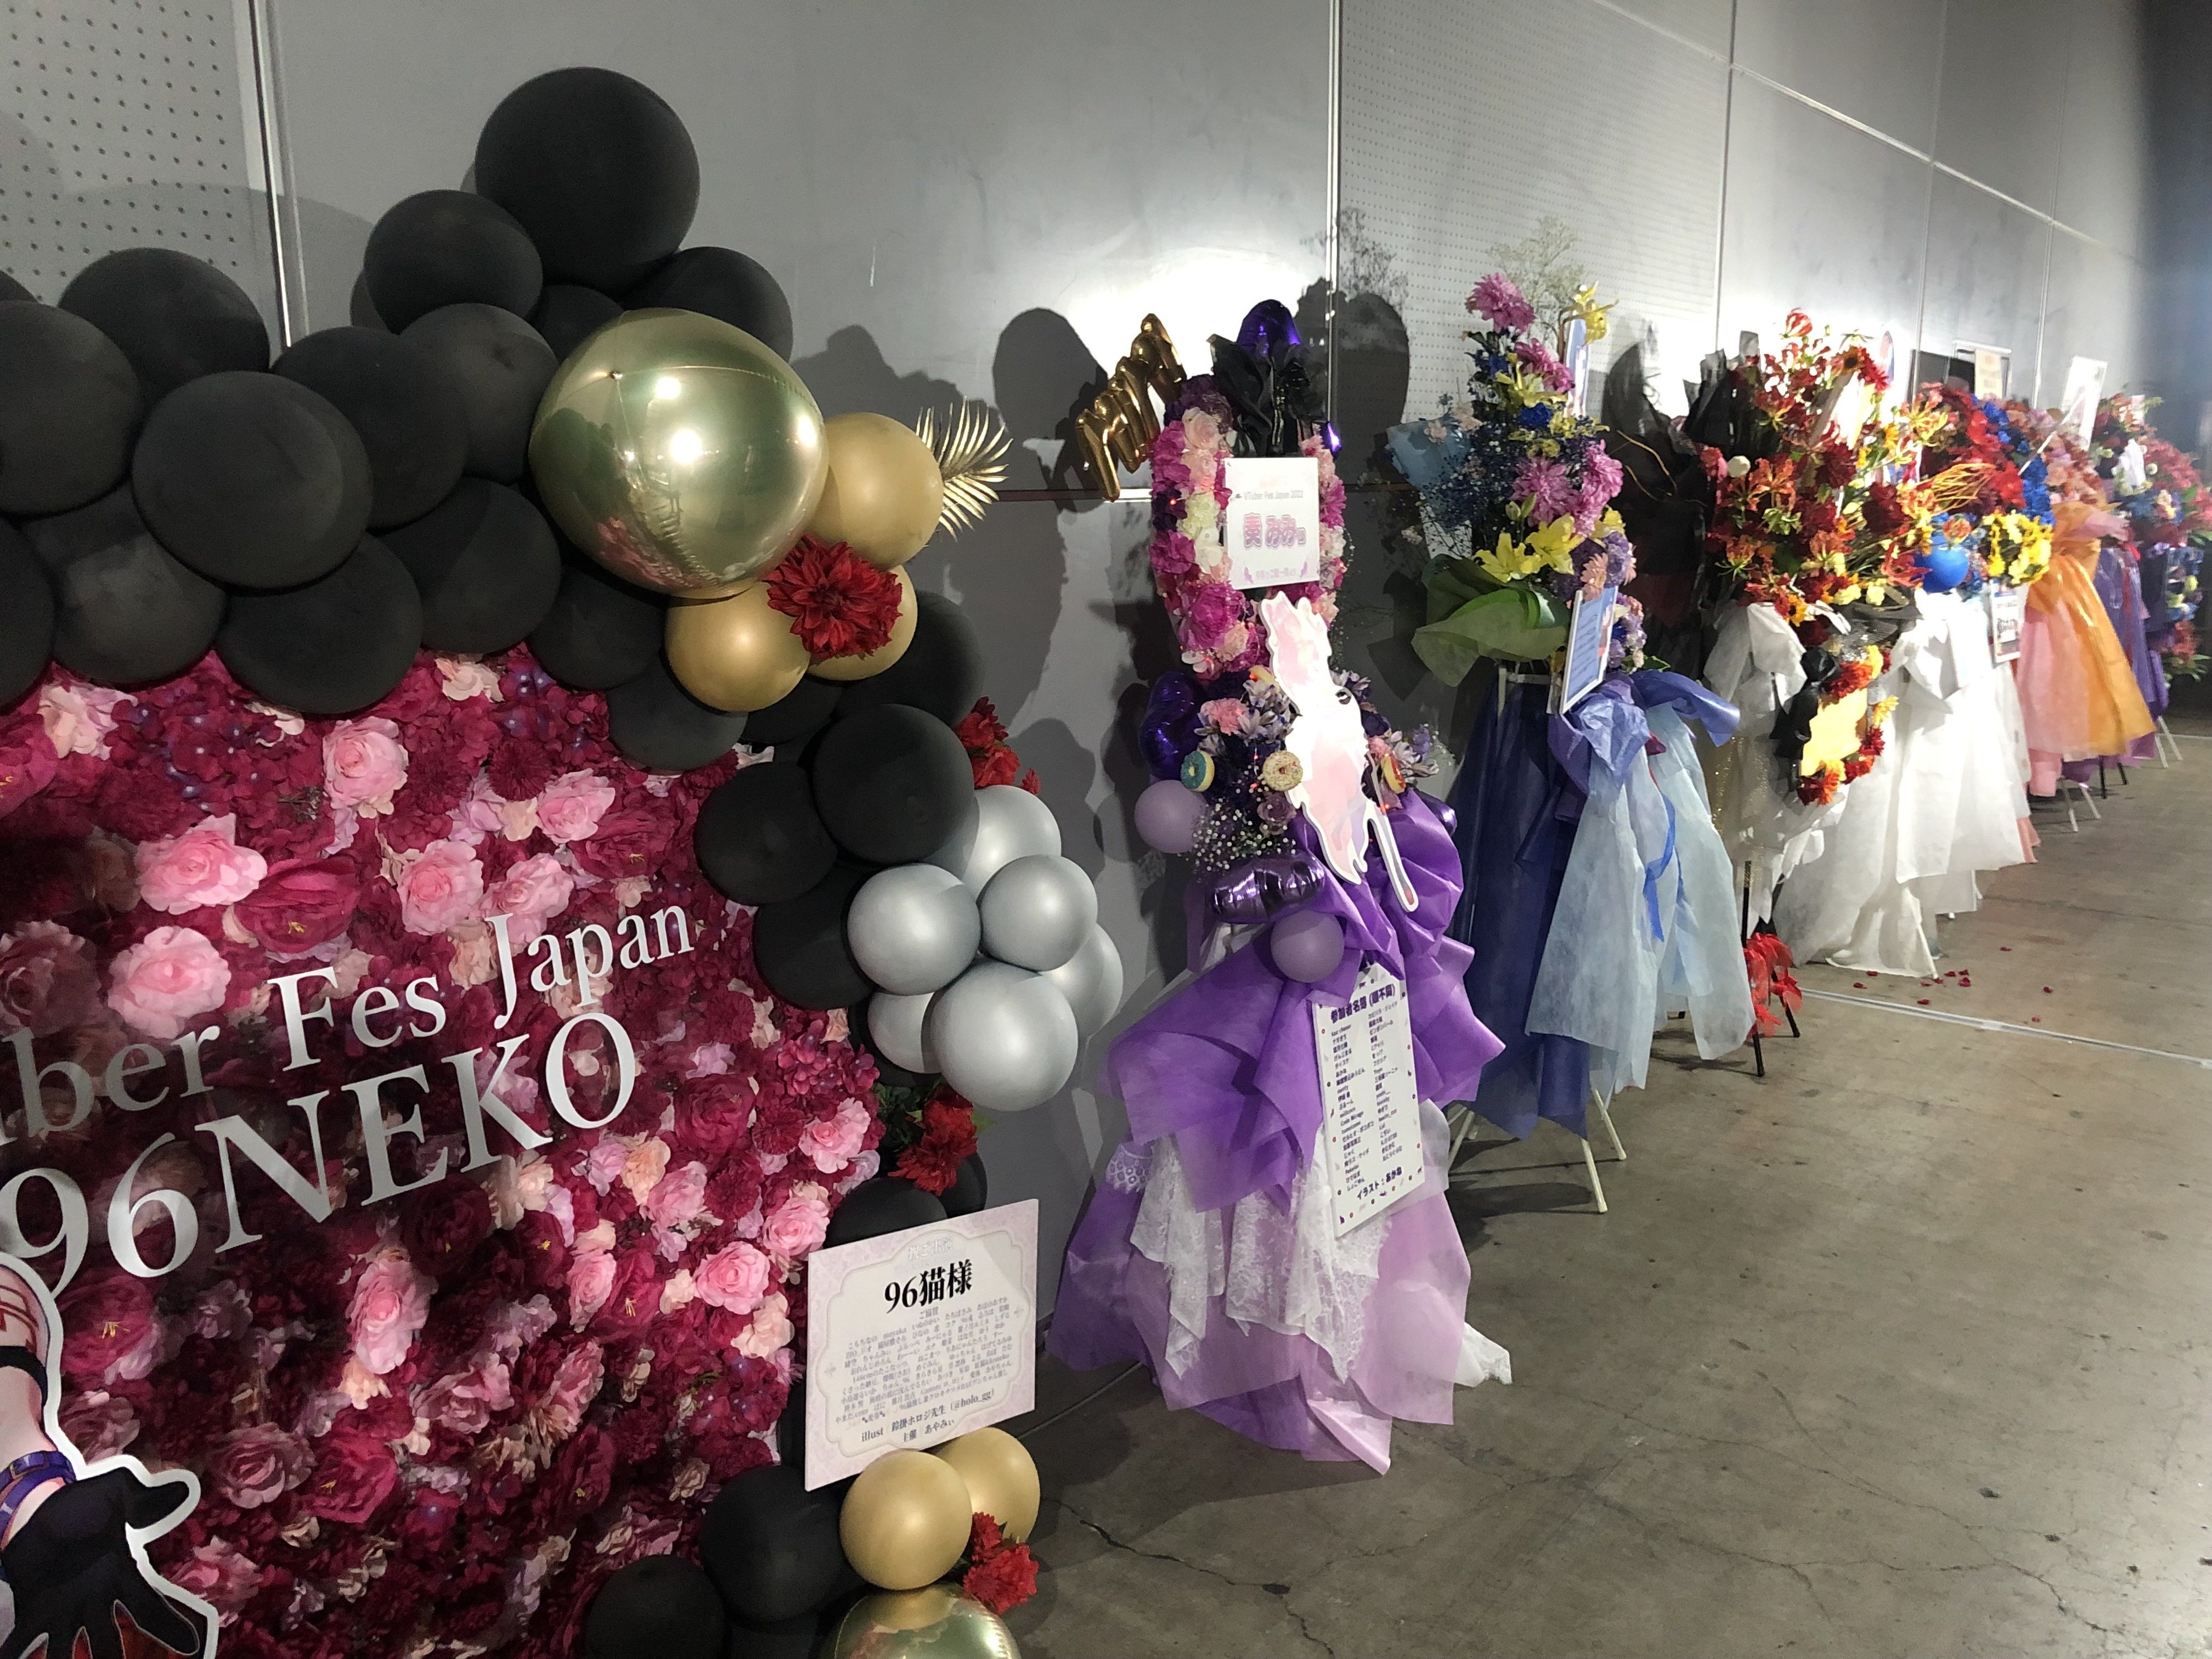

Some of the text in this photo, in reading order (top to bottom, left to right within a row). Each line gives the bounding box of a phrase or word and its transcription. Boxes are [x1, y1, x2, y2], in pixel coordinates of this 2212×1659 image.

[0, 902, 695, 1149] ber Fes Japan
[0, 1013, 636, 1299] 96NEKO
[884, 1257, 973, 1317] 96猫様
[861, 1426, 883, 1443] illust
